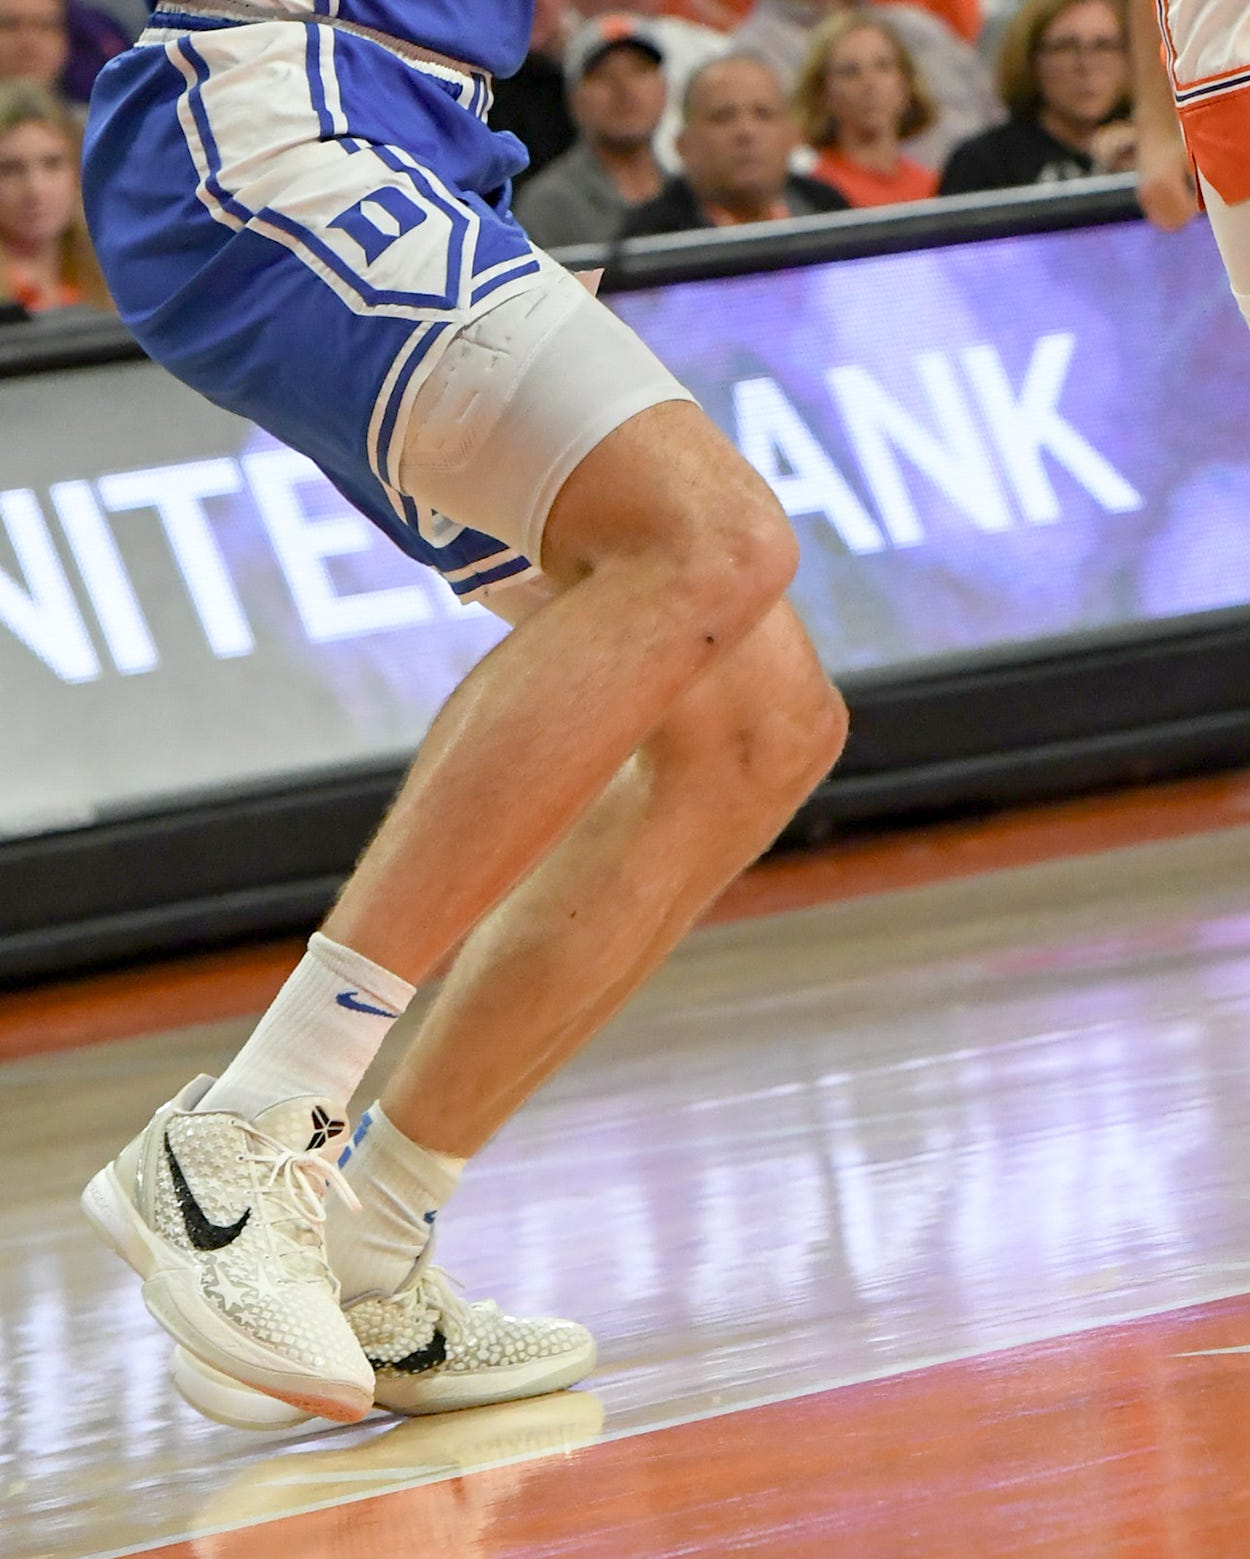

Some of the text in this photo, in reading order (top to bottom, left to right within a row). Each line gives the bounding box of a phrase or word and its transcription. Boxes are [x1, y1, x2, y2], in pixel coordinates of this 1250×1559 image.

[325, 186, 427, 268] D
[0, 333, 1145, 685] NITE ANK
